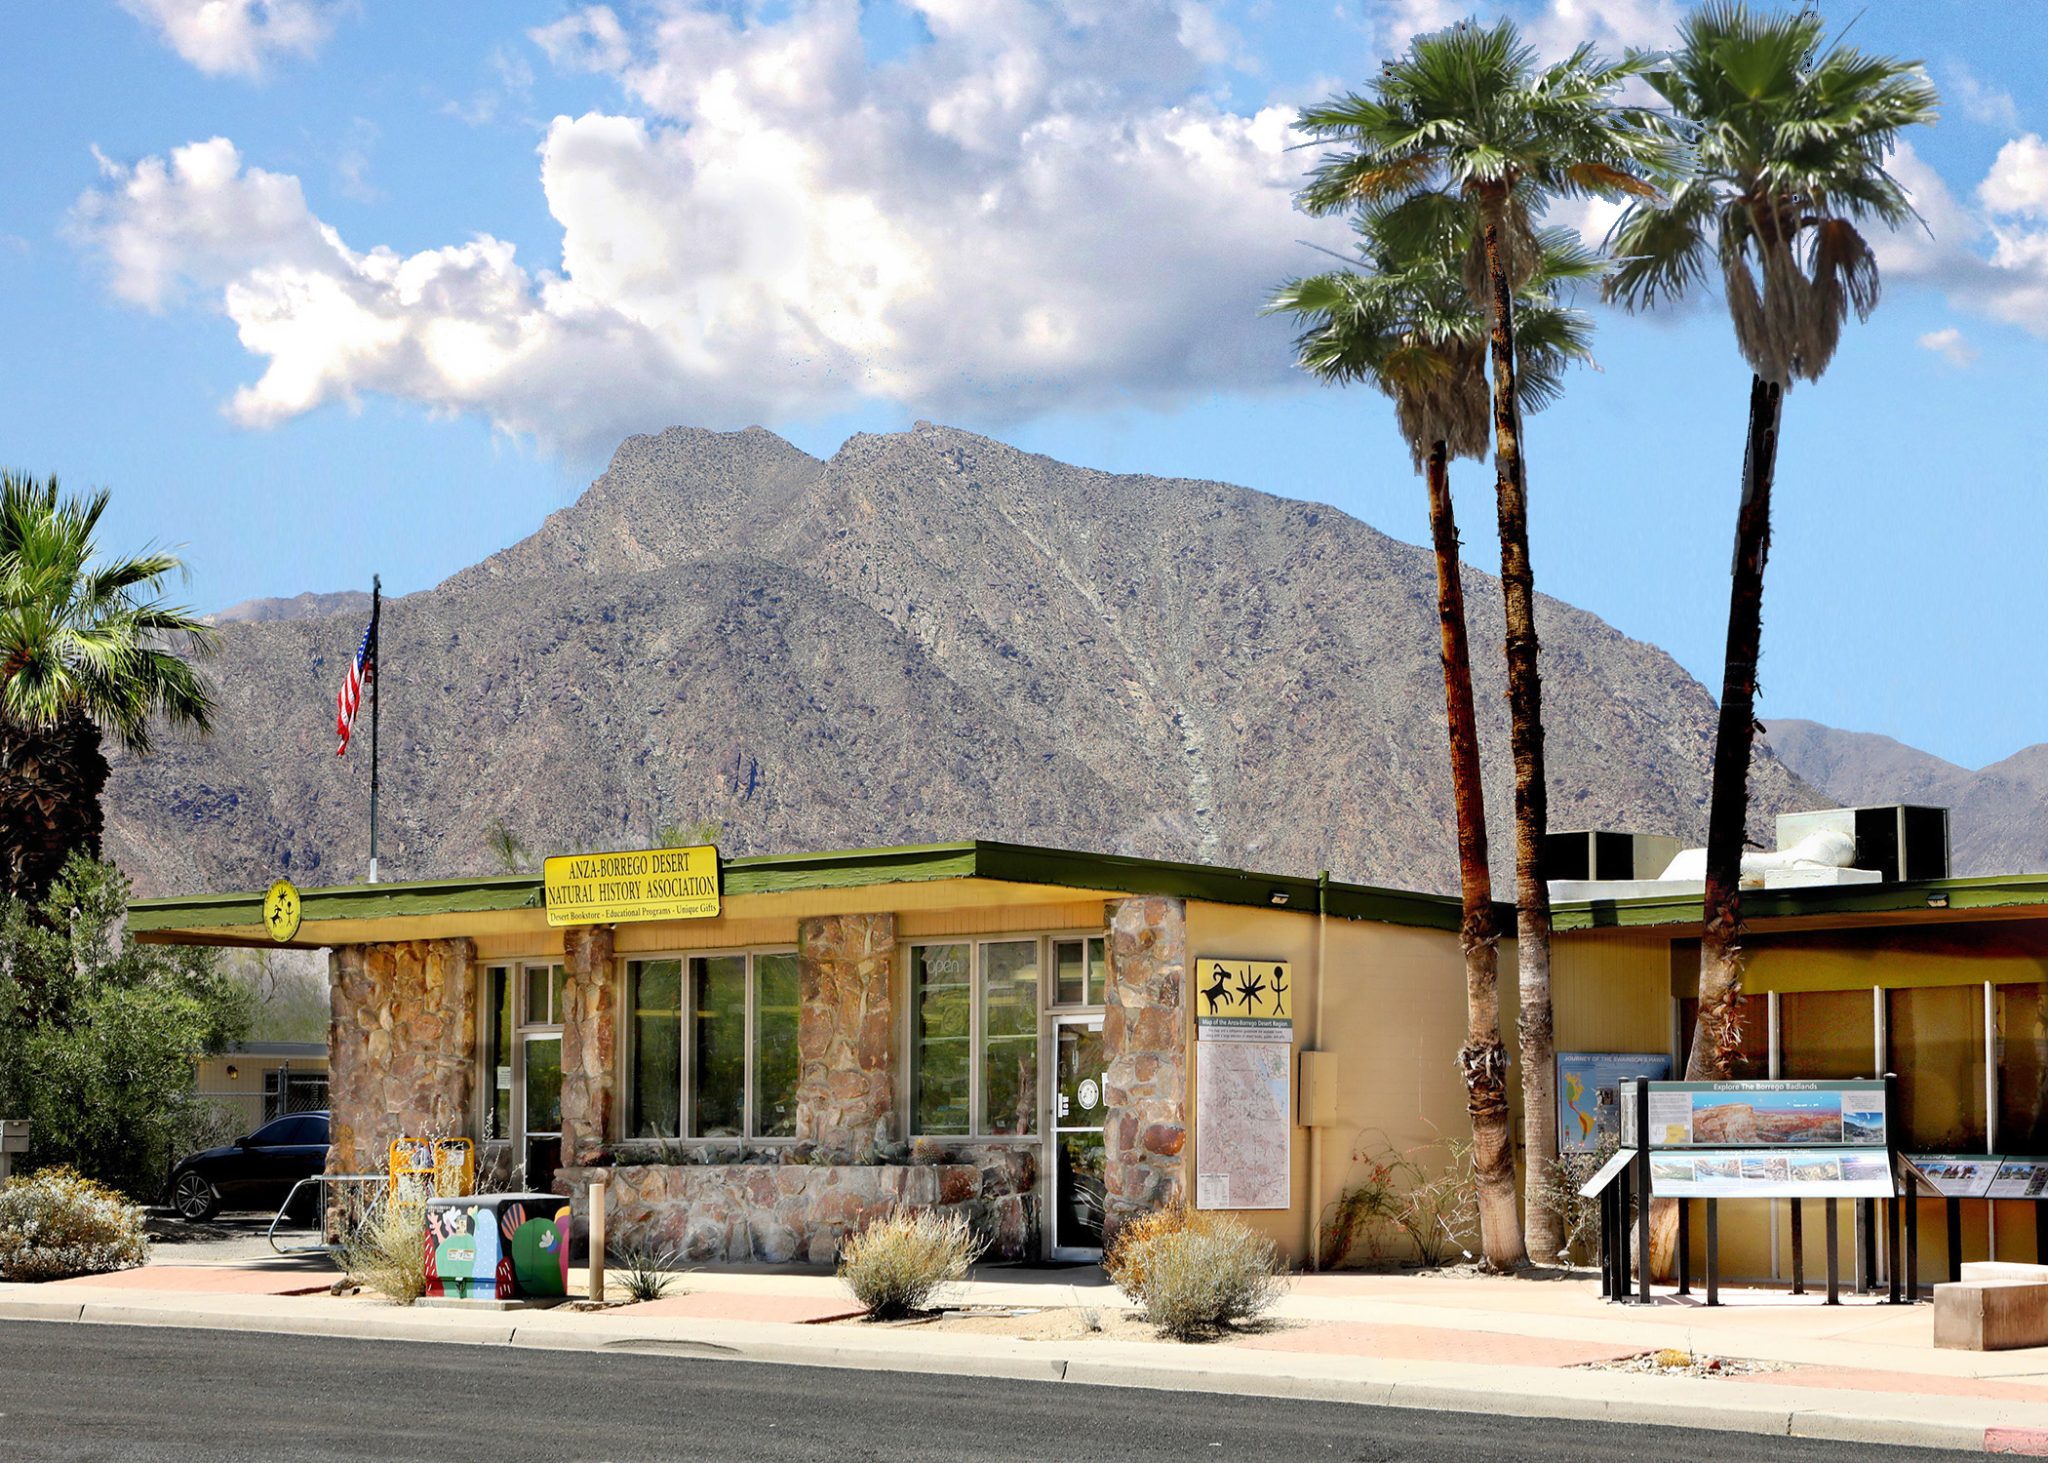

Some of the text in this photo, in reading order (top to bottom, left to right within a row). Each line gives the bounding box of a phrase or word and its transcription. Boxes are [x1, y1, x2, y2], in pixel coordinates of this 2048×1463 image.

[569, 852, 690, 879] ANZA-BORREGO DESERT
[548, 876, 715, 905] NATURAL HISTORY ASSOCIATION
[550, 912, 570, 922] Desert
[570, 911, 601, 921] Bookstore
[605, 907, 641, 918] Educational
[642, 906, 671, 919] Programs
[676, 904, 699, 916] Unique
[699, 903, 717, 913] Gifts
[927, 959, 960, 977] open
[1202, 1019, 1212, 1027] Map
[1273, 1020, 1288, 1028] Region
[1713, 1083, 1740, 1091] Explore
[1756, 1083, 1785, 1091] Borrego
